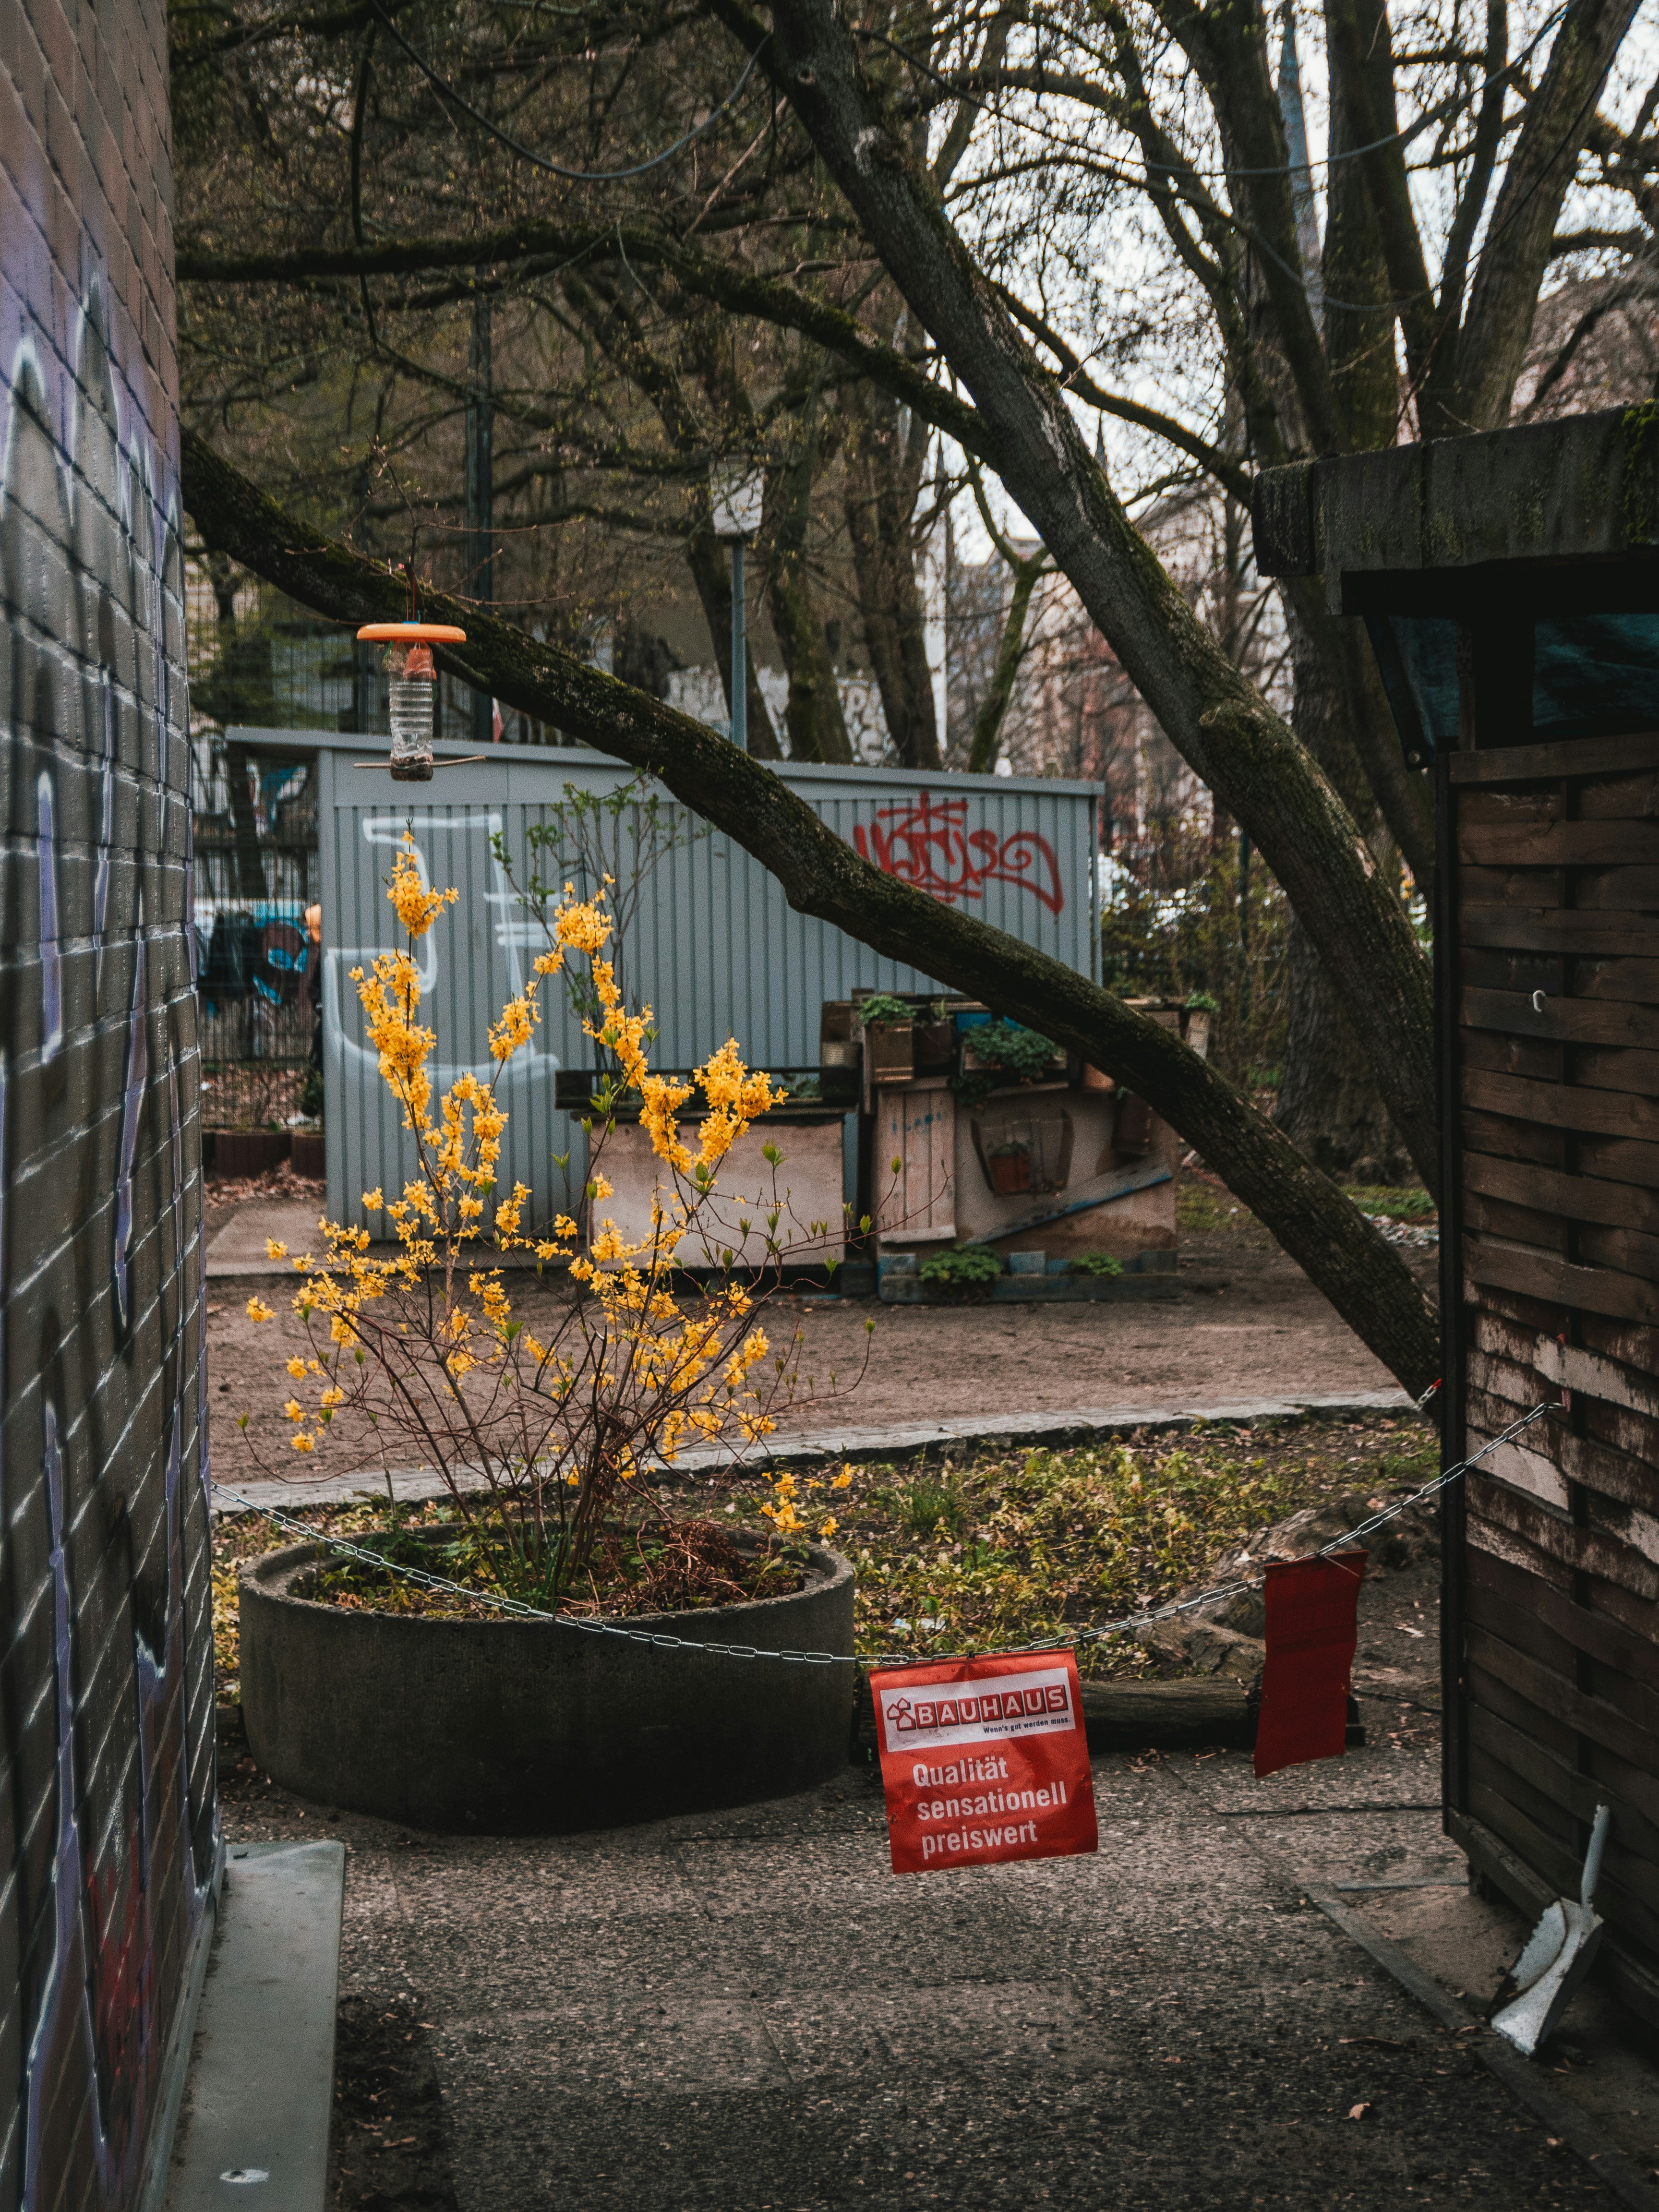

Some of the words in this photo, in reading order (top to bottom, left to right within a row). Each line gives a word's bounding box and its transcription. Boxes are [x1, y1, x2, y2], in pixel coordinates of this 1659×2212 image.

[916, 1687, 1065, 1725] BAUHAUS
[984, 1725, 1009, 1734] Wenn's
[1010, 1723, 1022, 1732] gut
[1023, 1719, 1048, 1729] werden
[913, 1756, 1009, 1787] Qualität
[917, 1781, 1067, 1820] sensationell
[922, 1821, 1037, 1860] preiswert
